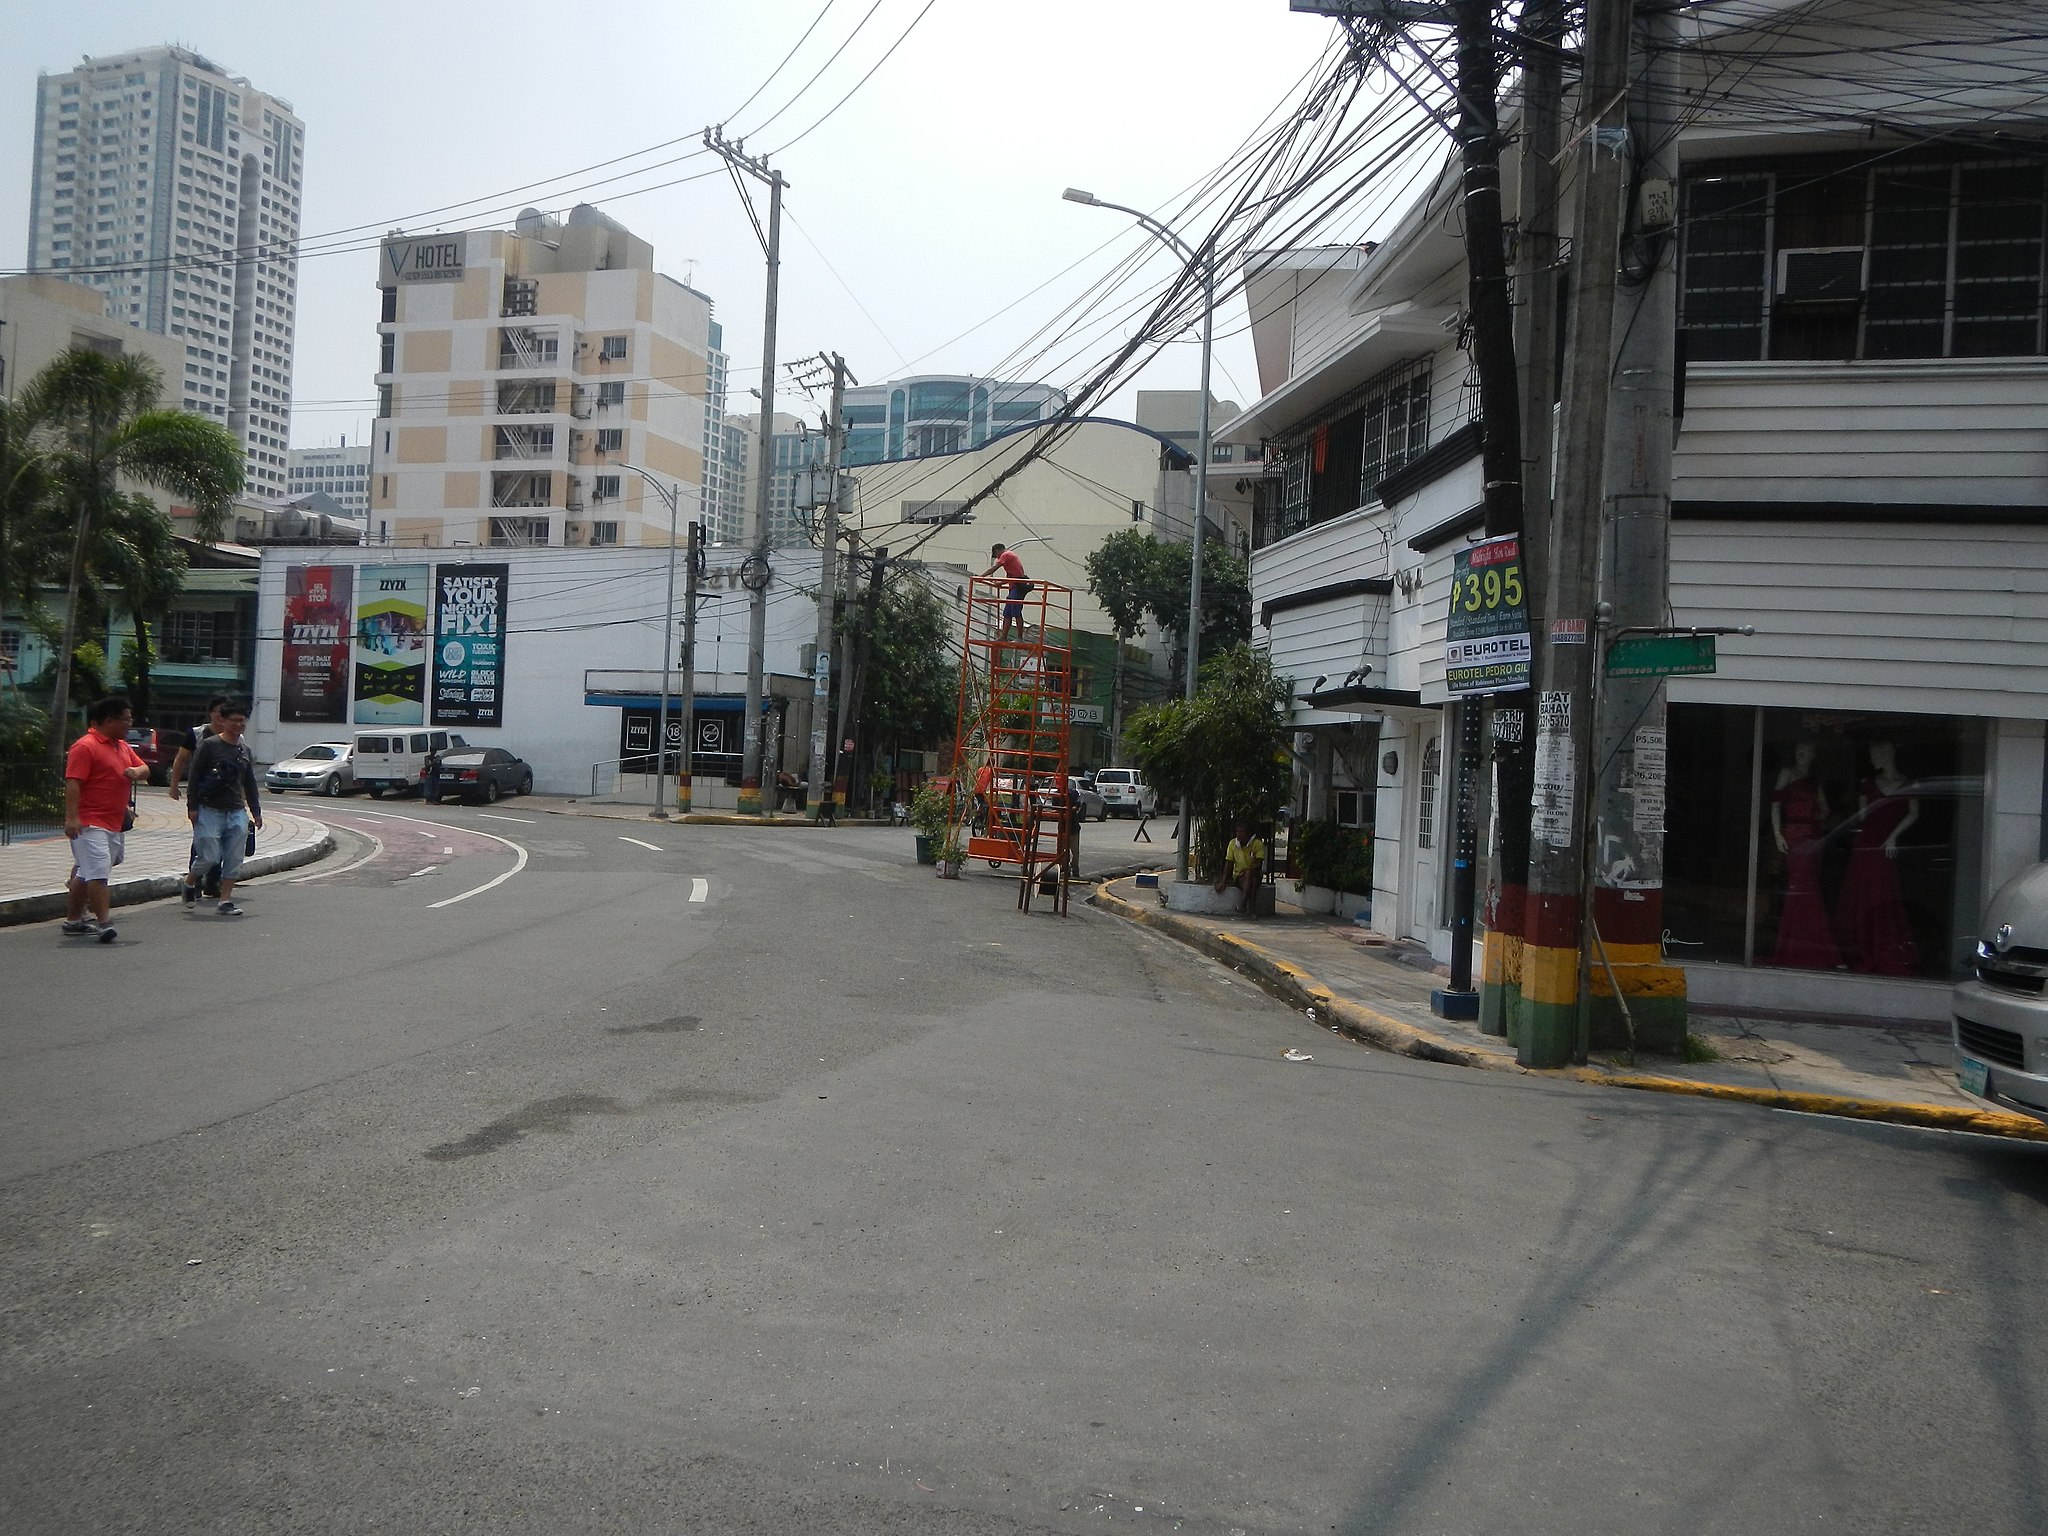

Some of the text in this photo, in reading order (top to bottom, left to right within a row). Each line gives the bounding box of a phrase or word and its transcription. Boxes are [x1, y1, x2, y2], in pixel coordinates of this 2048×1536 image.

[388, 244, 411, 277] V
[415, 244, 461, 269] HOTEL
[380, 578, 406, 591] ZZYZX
[443, 576, 499, 588] SATISFY
[309, 594, 327, 602] STOP
[443, 587, 498, 604] YOUR
[441, 603, 498, 615] NIGHTLY
[440, 613, 498, 638] FIX!
[1463, 640, 1530, 656] EUROTEL
[439, 669, 466, 679] WILD
[1448, 663, 1528, 681] EUROTEL PEDRO GIL
[1540, 703, 1569, 714] BAHAY
[670, 727, 681, 737] 18
